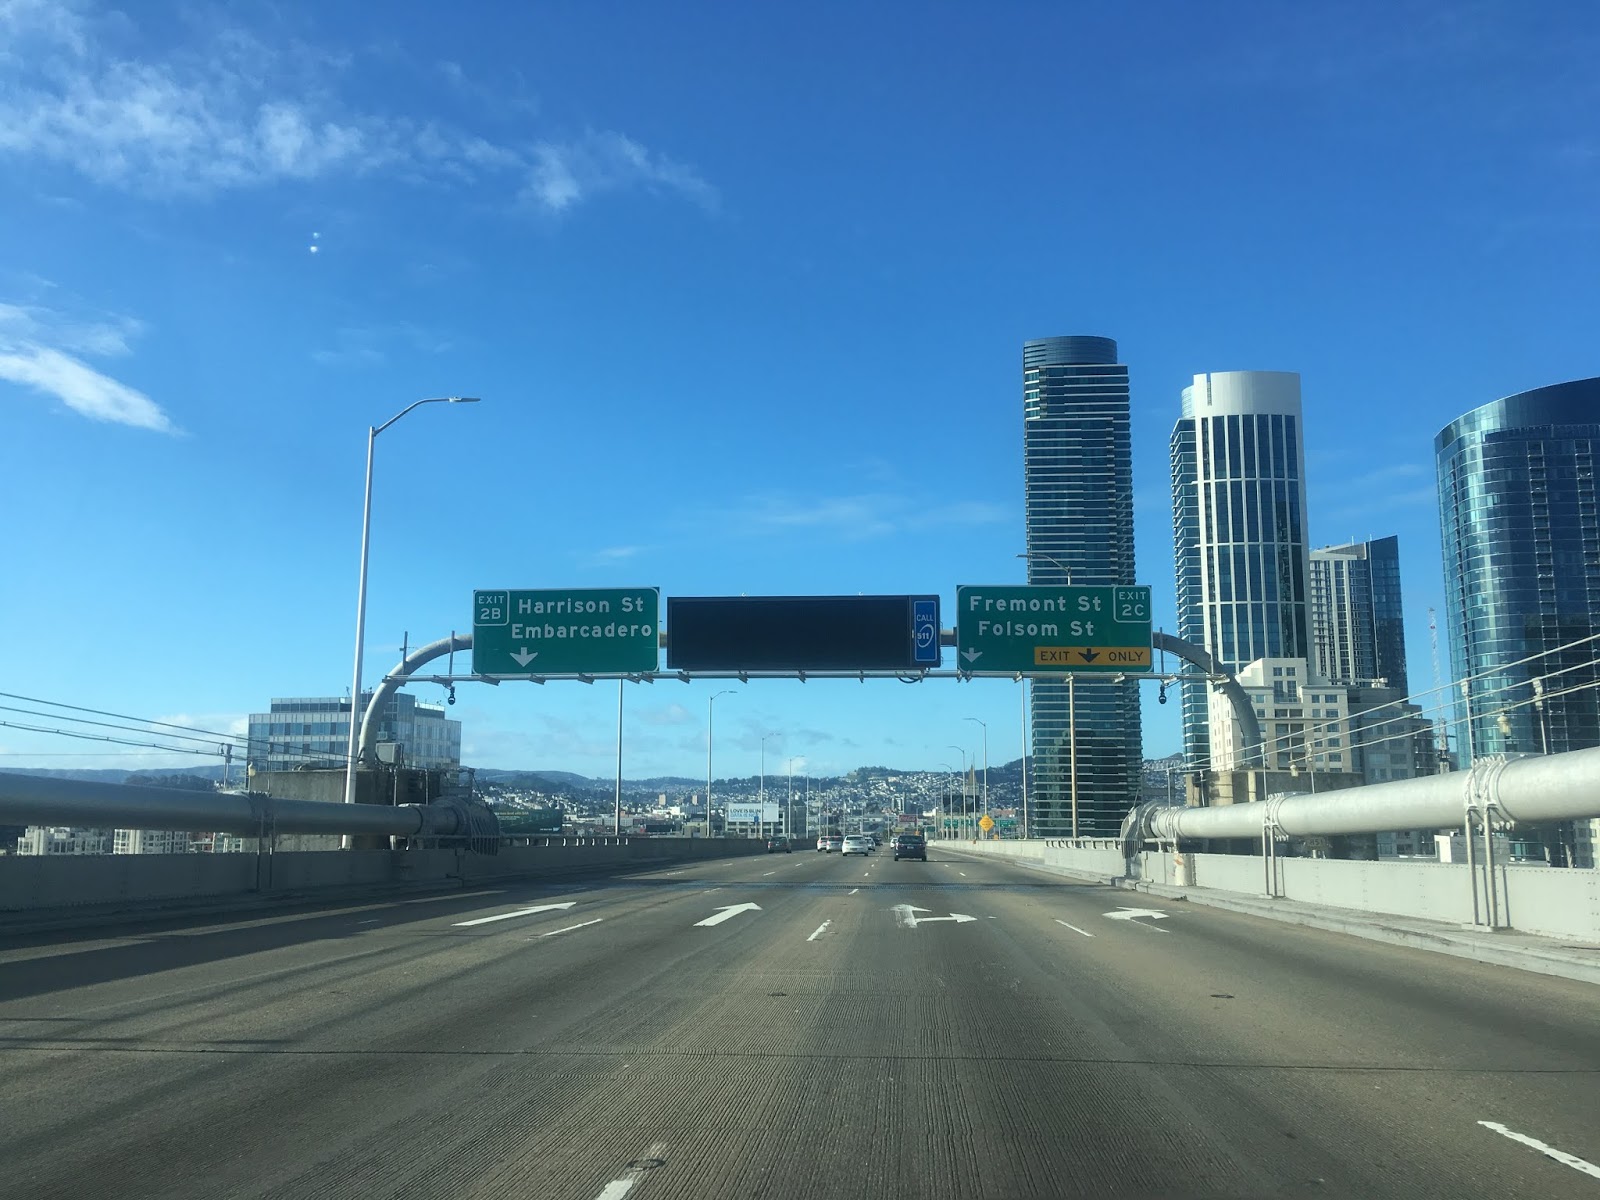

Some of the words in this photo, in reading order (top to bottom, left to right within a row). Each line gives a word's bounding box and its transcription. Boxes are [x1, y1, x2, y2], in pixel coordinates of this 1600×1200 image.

[478, 595, 504, 604] EXIT
[1118, 591, 1147, 600] EXIT
[518, 597, 610, 614] Harrison
[621, 596, 644, 613] St
[969, 595, 1066, 612] Fremont
[1077, 595, 1101, 612] St
[480, 607, 501, 620] 2B
[1121, 604, 1145, 616] 2C
[916, 614, 934, 622] CALL
[511, 622, 652, 639] Embarcadero
[978, 620, 1058, 636] Folsom
[1070, 620, 1095, 636] St
[917, 632, 930, 640] 511
[1040, 650, 1070, 662] EXIT
[1108, 650, 1144, 662] ONLY
